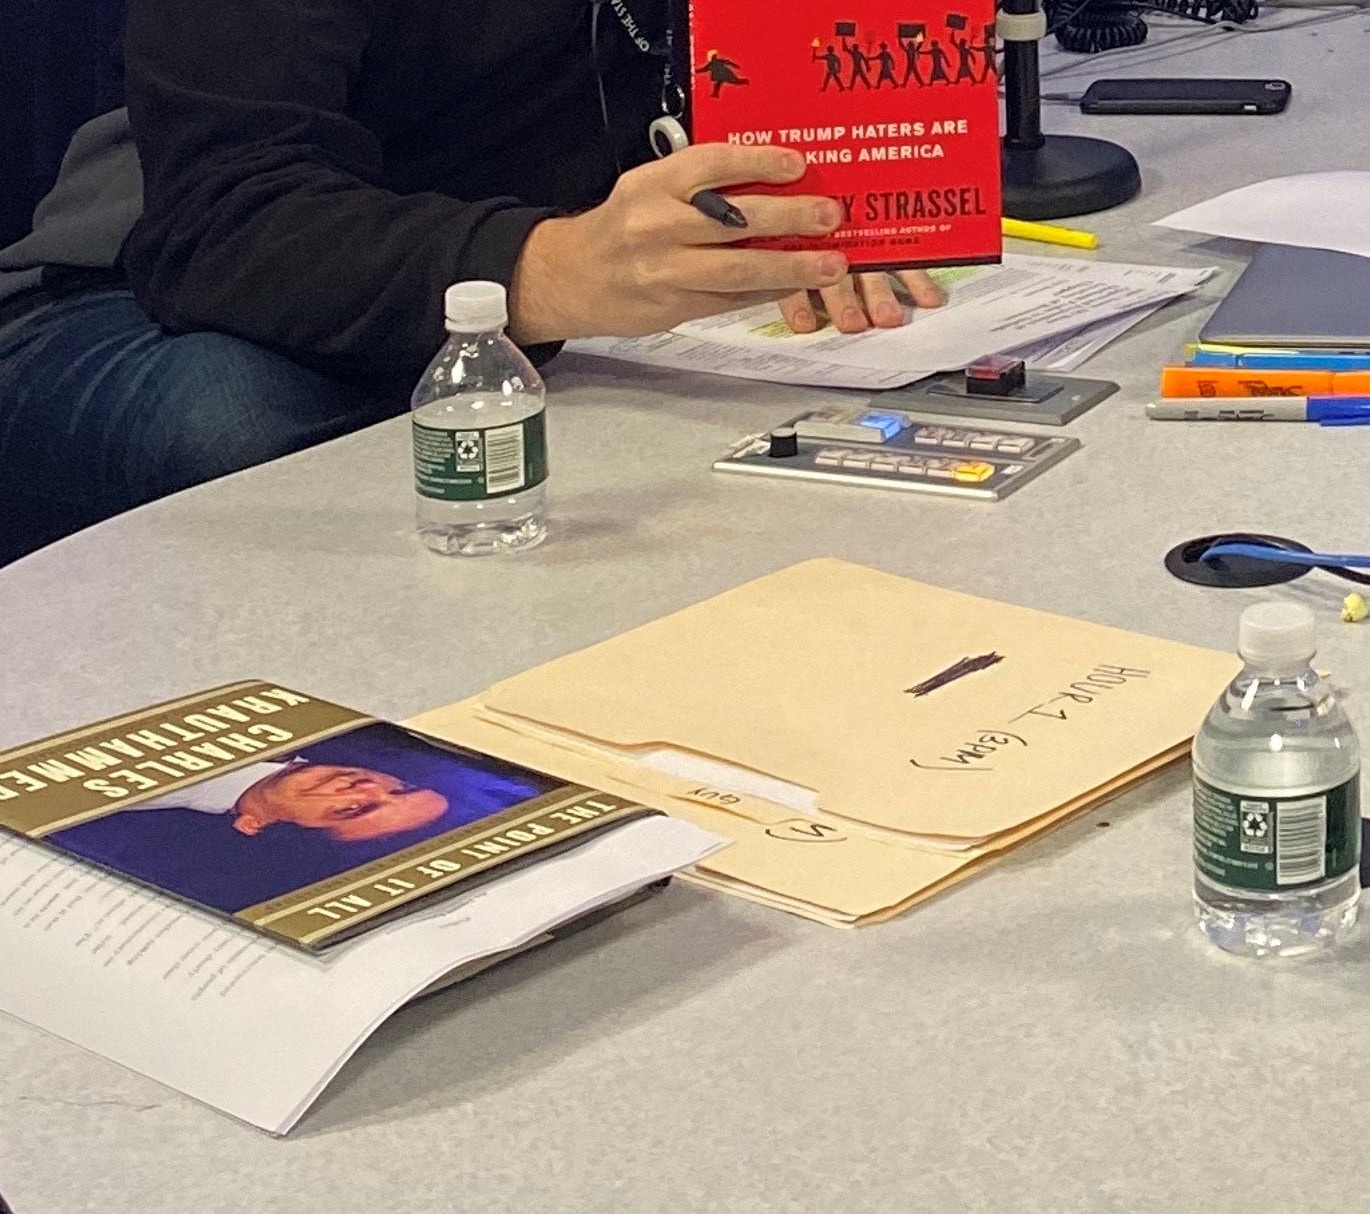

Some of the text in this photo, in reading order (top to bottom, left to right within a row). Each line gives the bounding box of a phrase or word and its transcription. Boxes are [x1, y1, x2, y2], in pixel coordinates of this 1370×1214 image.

[728, 119, 968, 146] HOW TRUMP HATERS ARE
[805, 143, 944, 165] KING AMERICA
[865, 188, 986, 222] STRASSEL
[83, 724, 293, 798] CHARLES
[550, 800, 617, 825] THE
[461, 823, 555, 860] POINT
[416, 859, 461, 879] OF
[374, 878, 415, 897] IT
[307, 894, 372, 919] ALL
